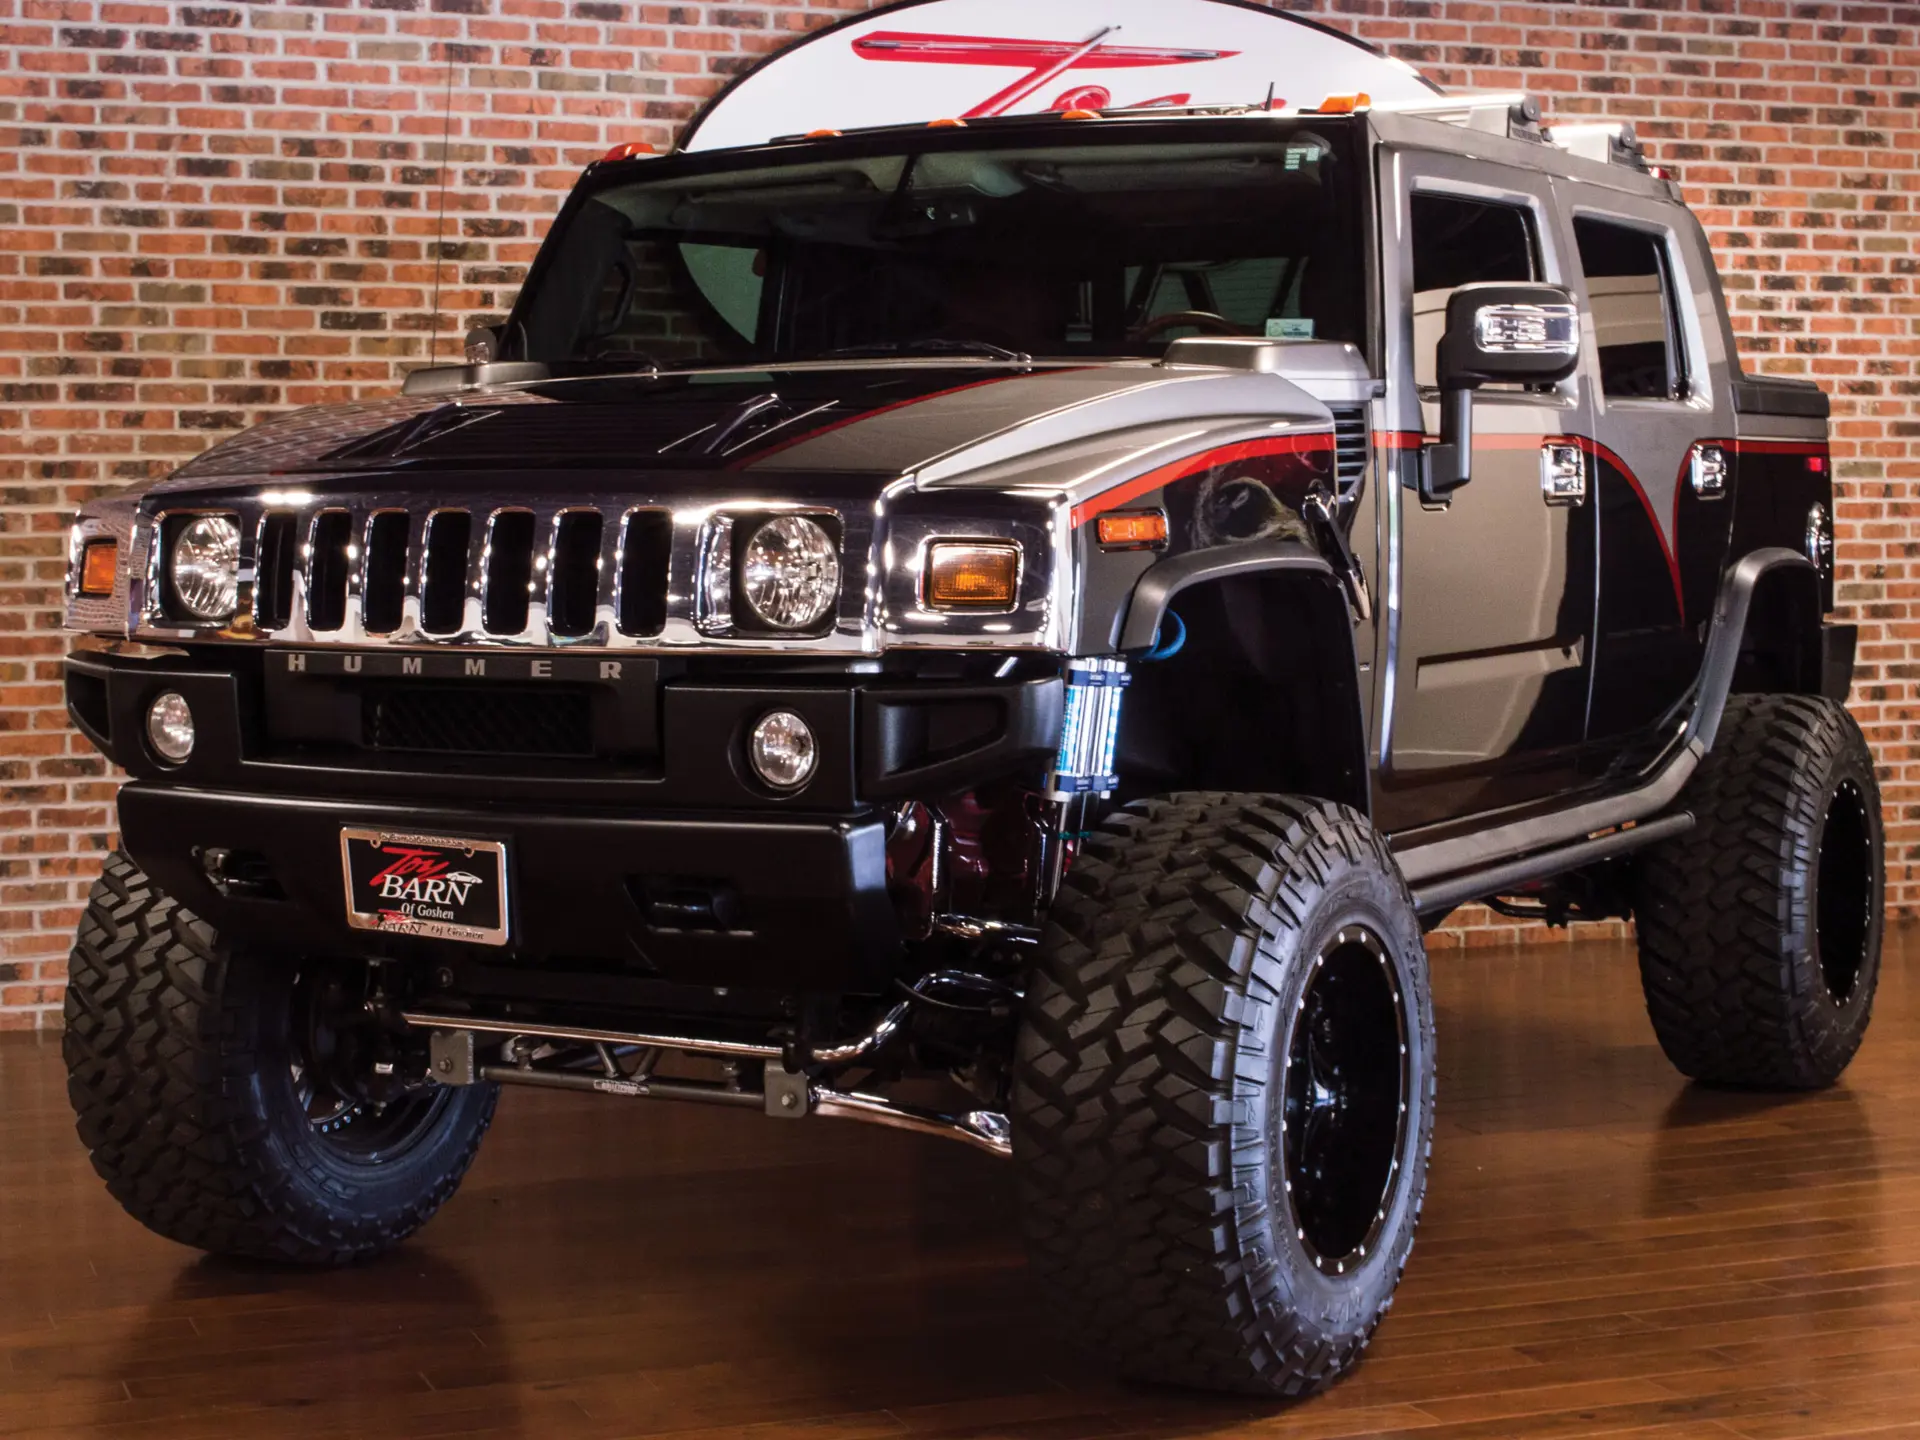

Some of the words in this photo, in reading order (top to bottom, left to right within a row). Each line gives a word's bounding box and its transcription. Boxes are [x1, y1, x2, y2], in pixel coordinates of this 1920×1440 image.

[288, 653, 622, 680] HUMMER
[369, 847, 449, 888] Toy
[379, 874, 472, 906] BARN
[401, 902, 415, 915] Of
[417, 905, 454, 920] Goshen
